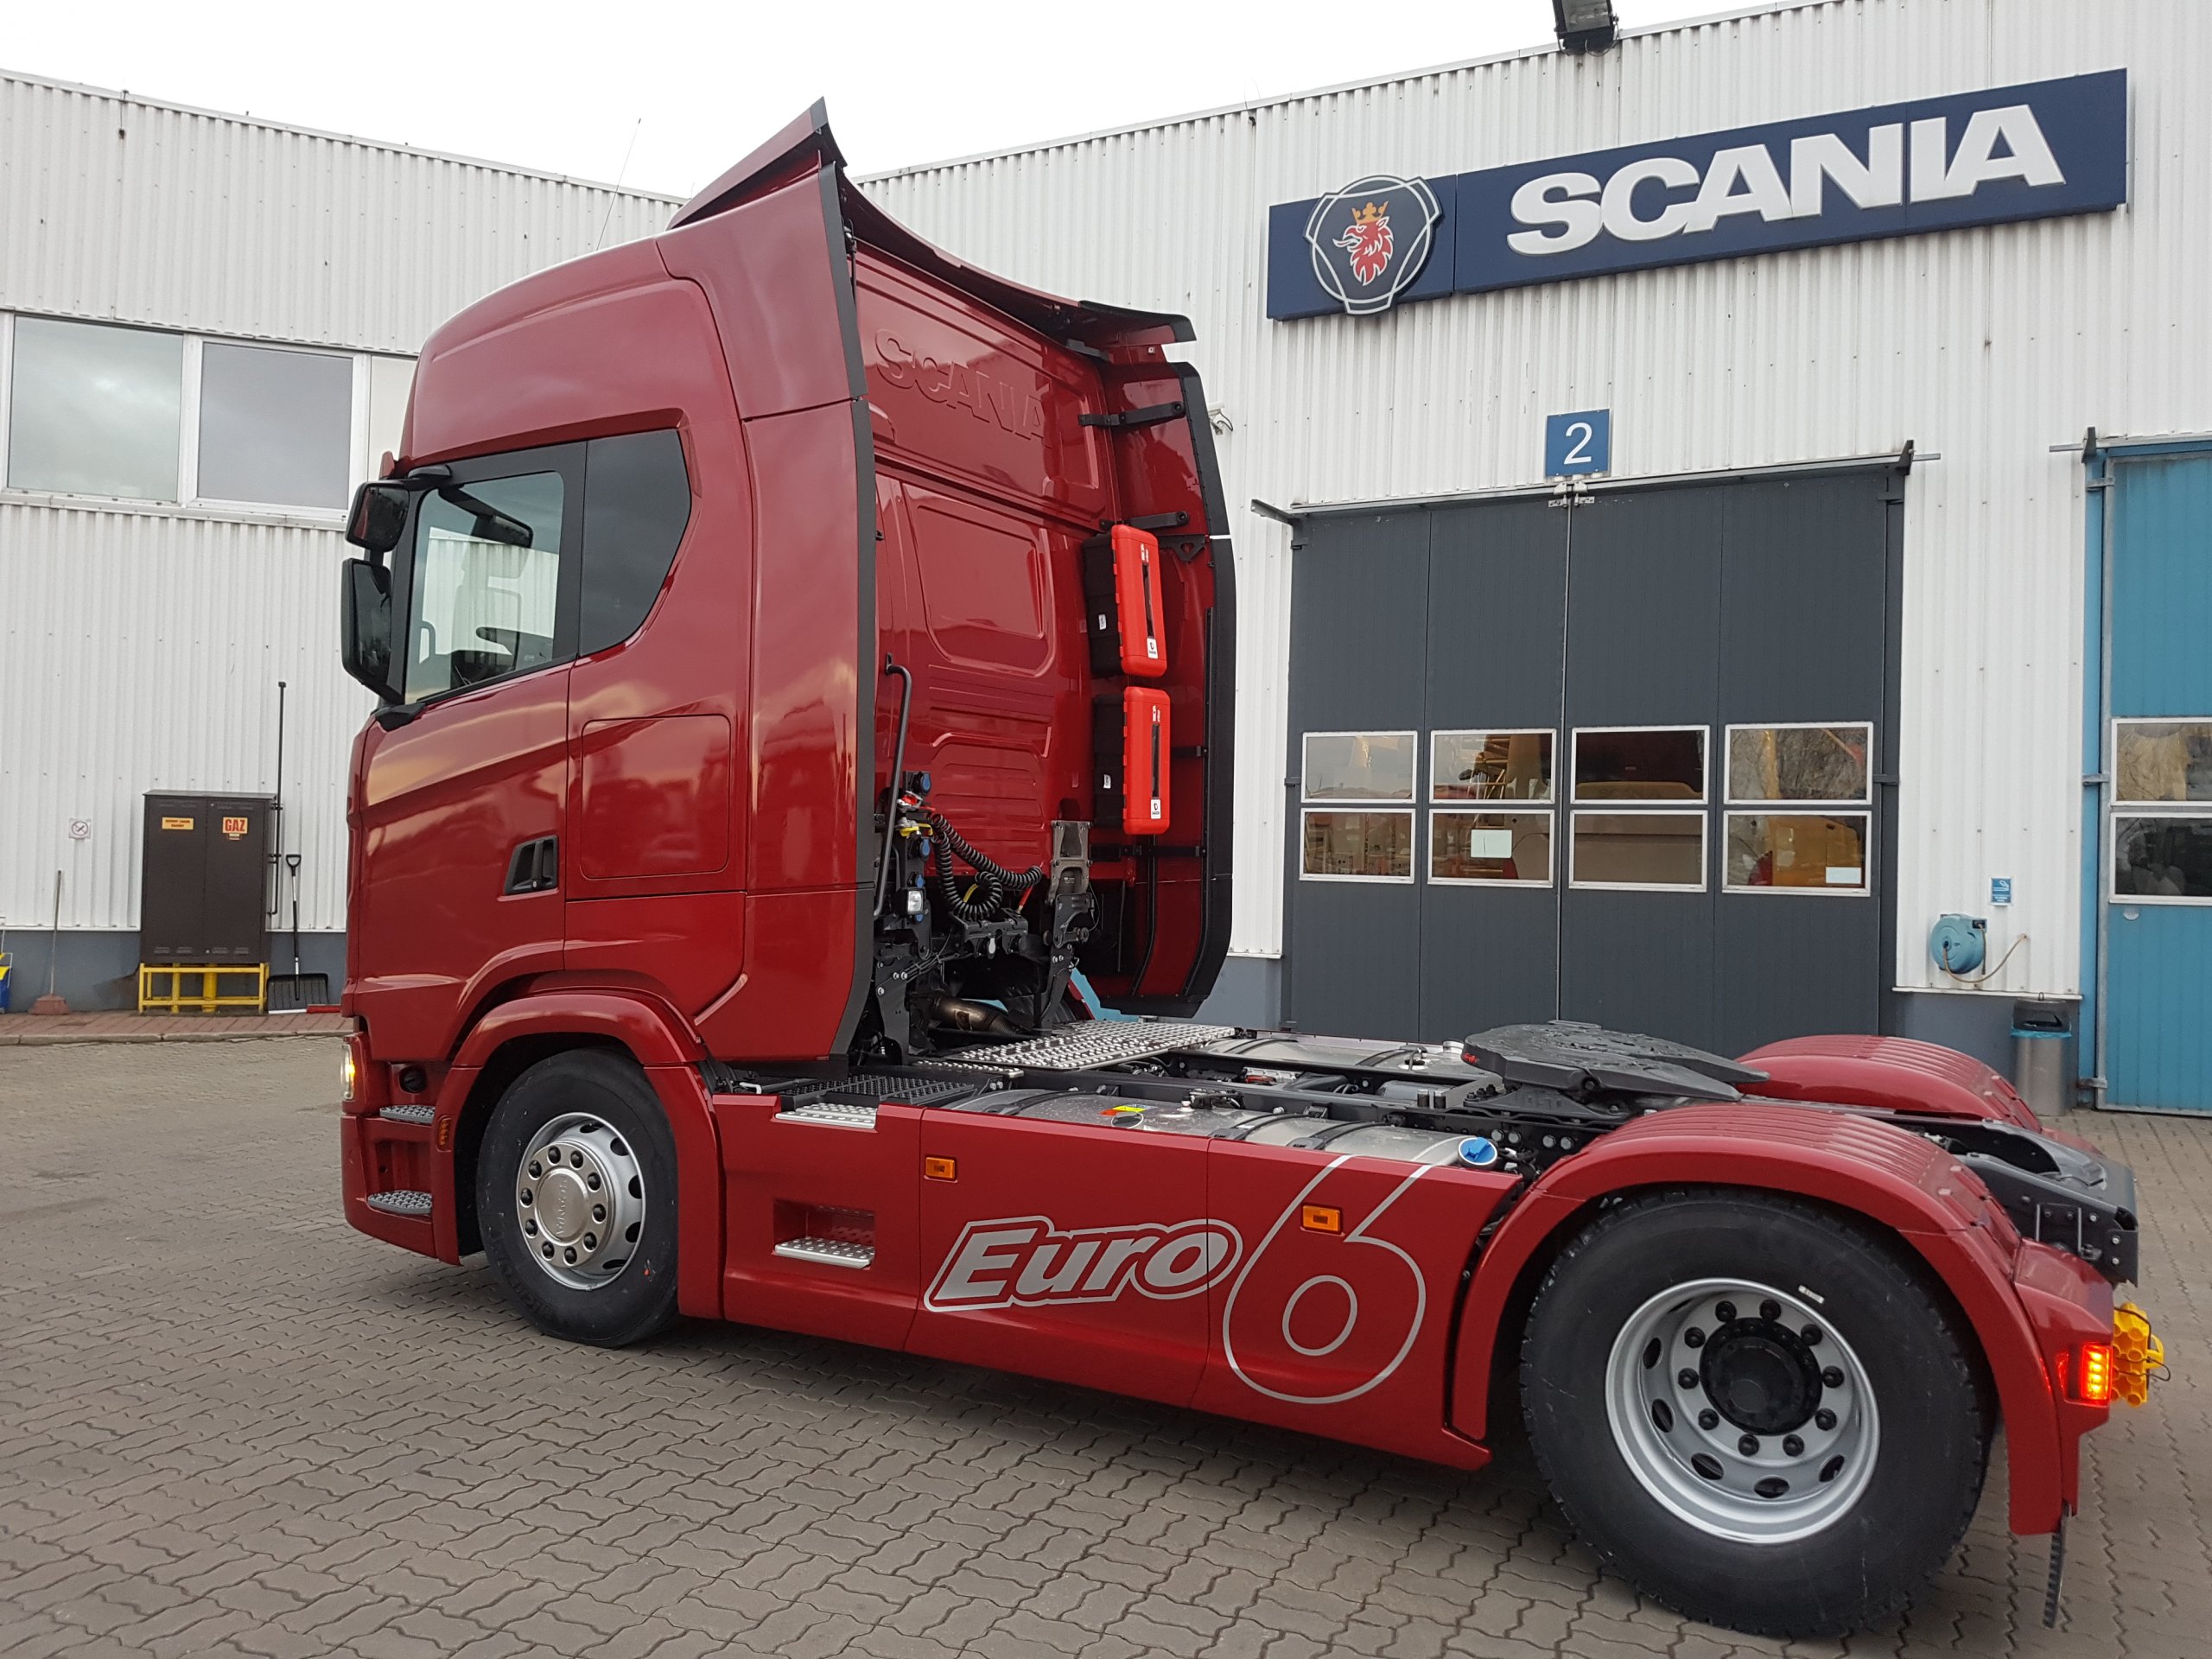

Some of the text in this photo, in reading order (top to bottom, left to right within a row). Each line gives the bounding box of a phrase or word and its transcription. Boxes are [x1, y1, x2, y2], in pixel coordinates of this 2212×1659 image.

[1506, 104, 2066, 255] SCANIA
[875, 328, 1052, 449] SCANIA
[1564, 422, 1592, 464] 2
[225, 819, 245, 832] GAZ
[931, 1154, 1436, 1405] Euro 6
